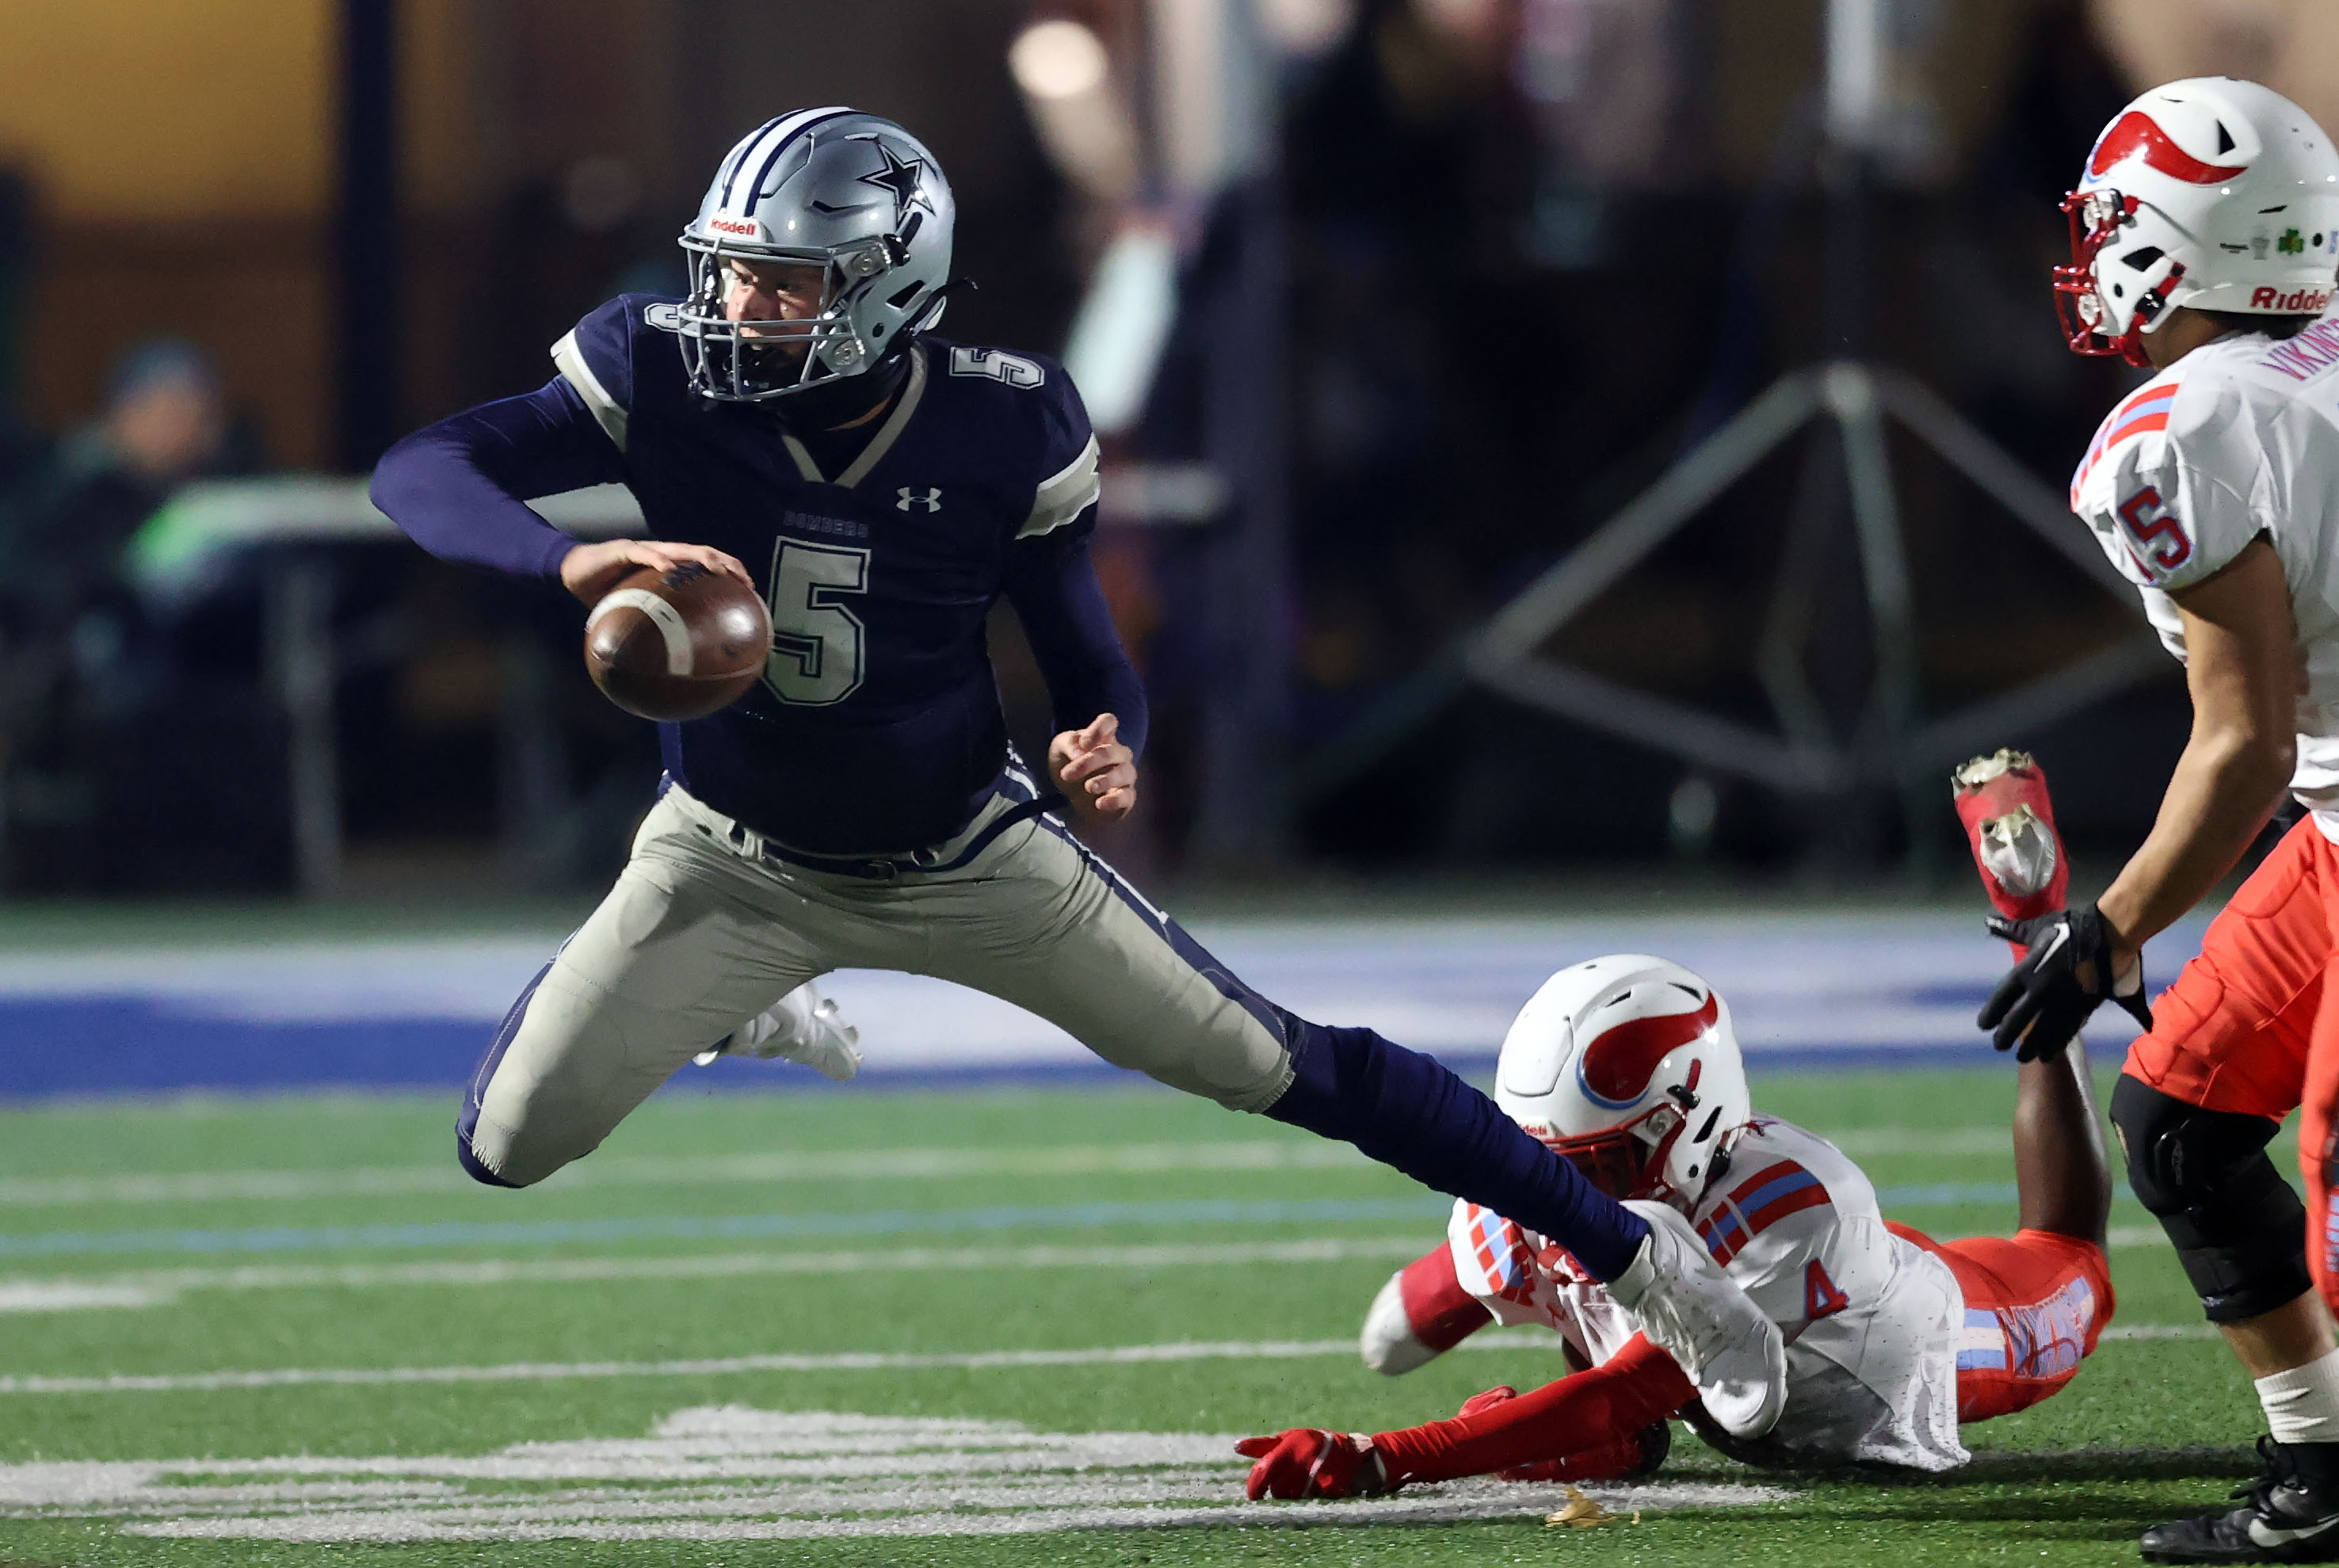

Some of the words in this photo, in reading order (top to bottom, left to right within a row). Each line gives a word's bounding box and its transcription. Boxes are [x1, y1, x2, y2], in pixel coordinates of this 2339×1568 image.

[2250, 286, 2331, 311] Ridde
[948, 346, 1045, 390] 5
[761, 535, 872, 708] 5
[1803, 1256, 1850, 1321] 4
